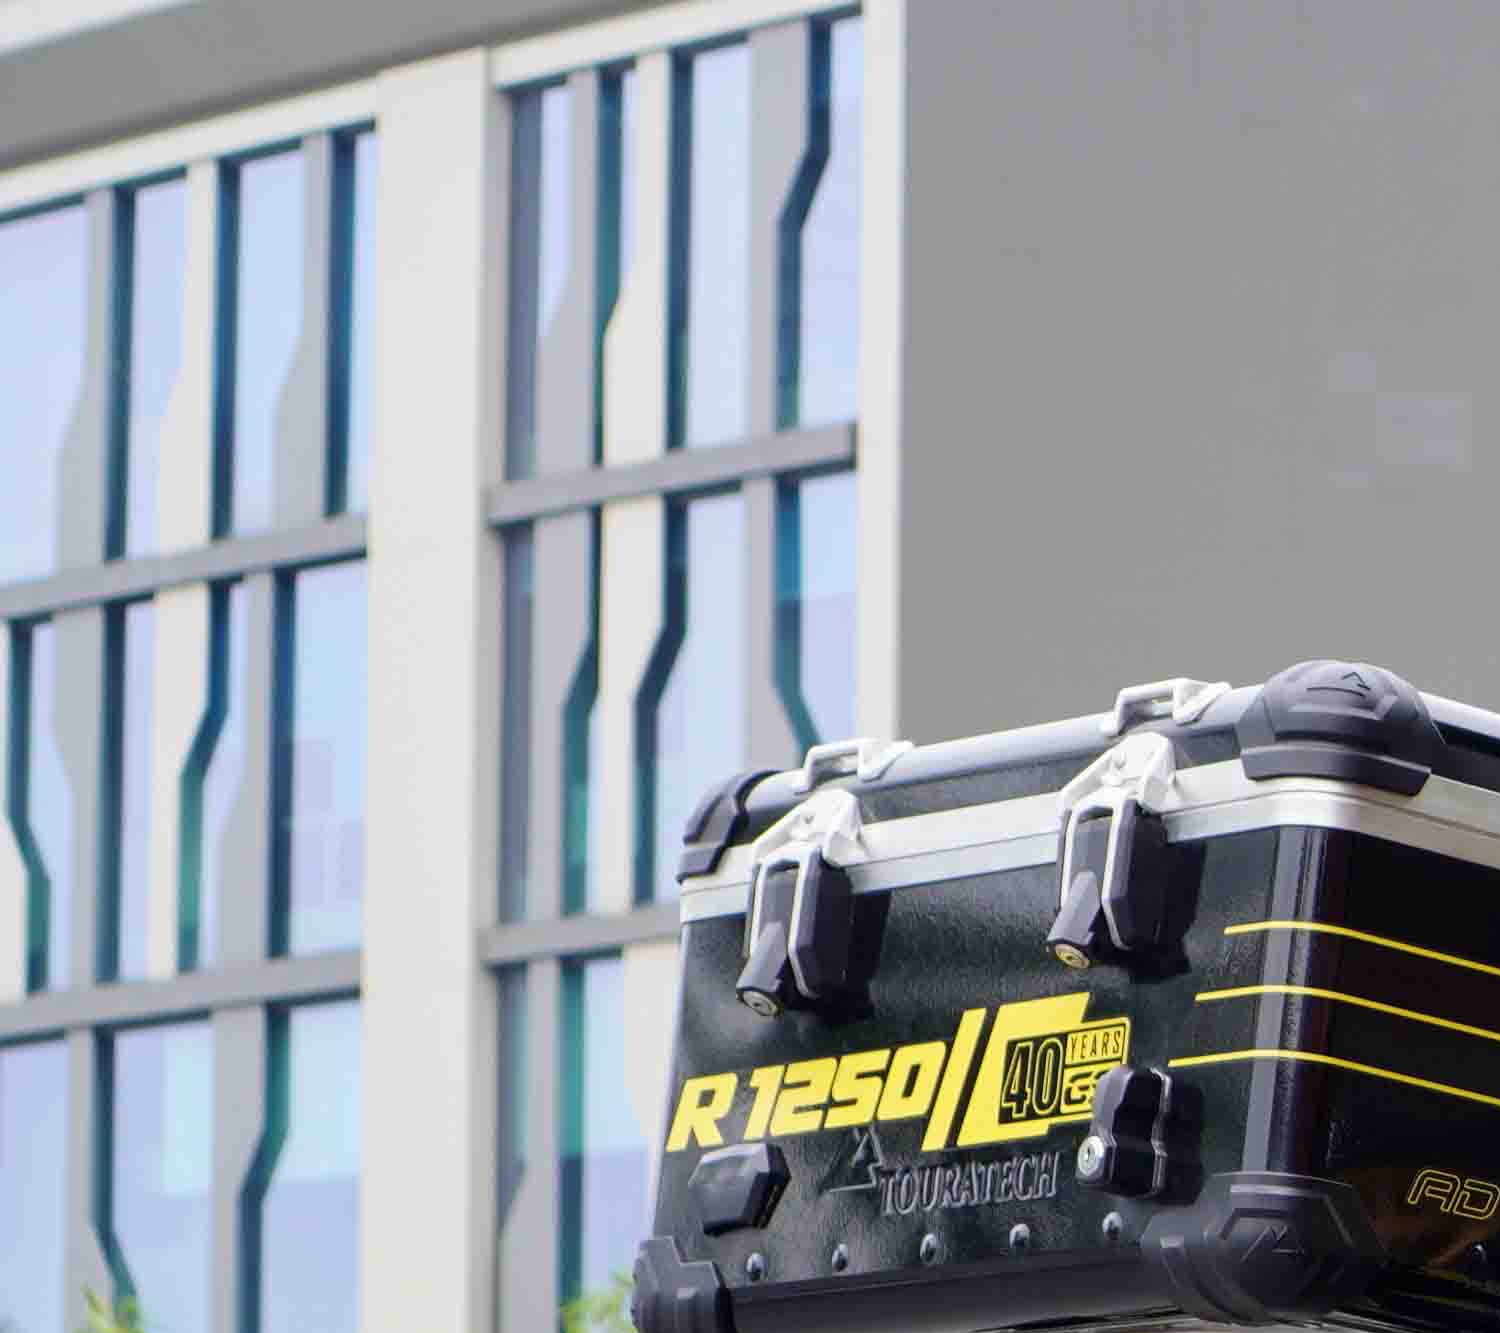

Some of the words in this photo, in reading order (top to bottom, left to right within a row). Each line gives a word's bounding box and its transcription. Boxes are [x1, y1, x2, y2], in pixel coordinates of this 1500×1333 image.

[666, 1072, 737, 1152] R
[743, 1040, 947, 1142] 1250
[1001, 1037, 1064, 1119] 40
[1070, 1029, 1121, 1061] YEARS
[879, 1151, 1060, 1216] TOURATECH
